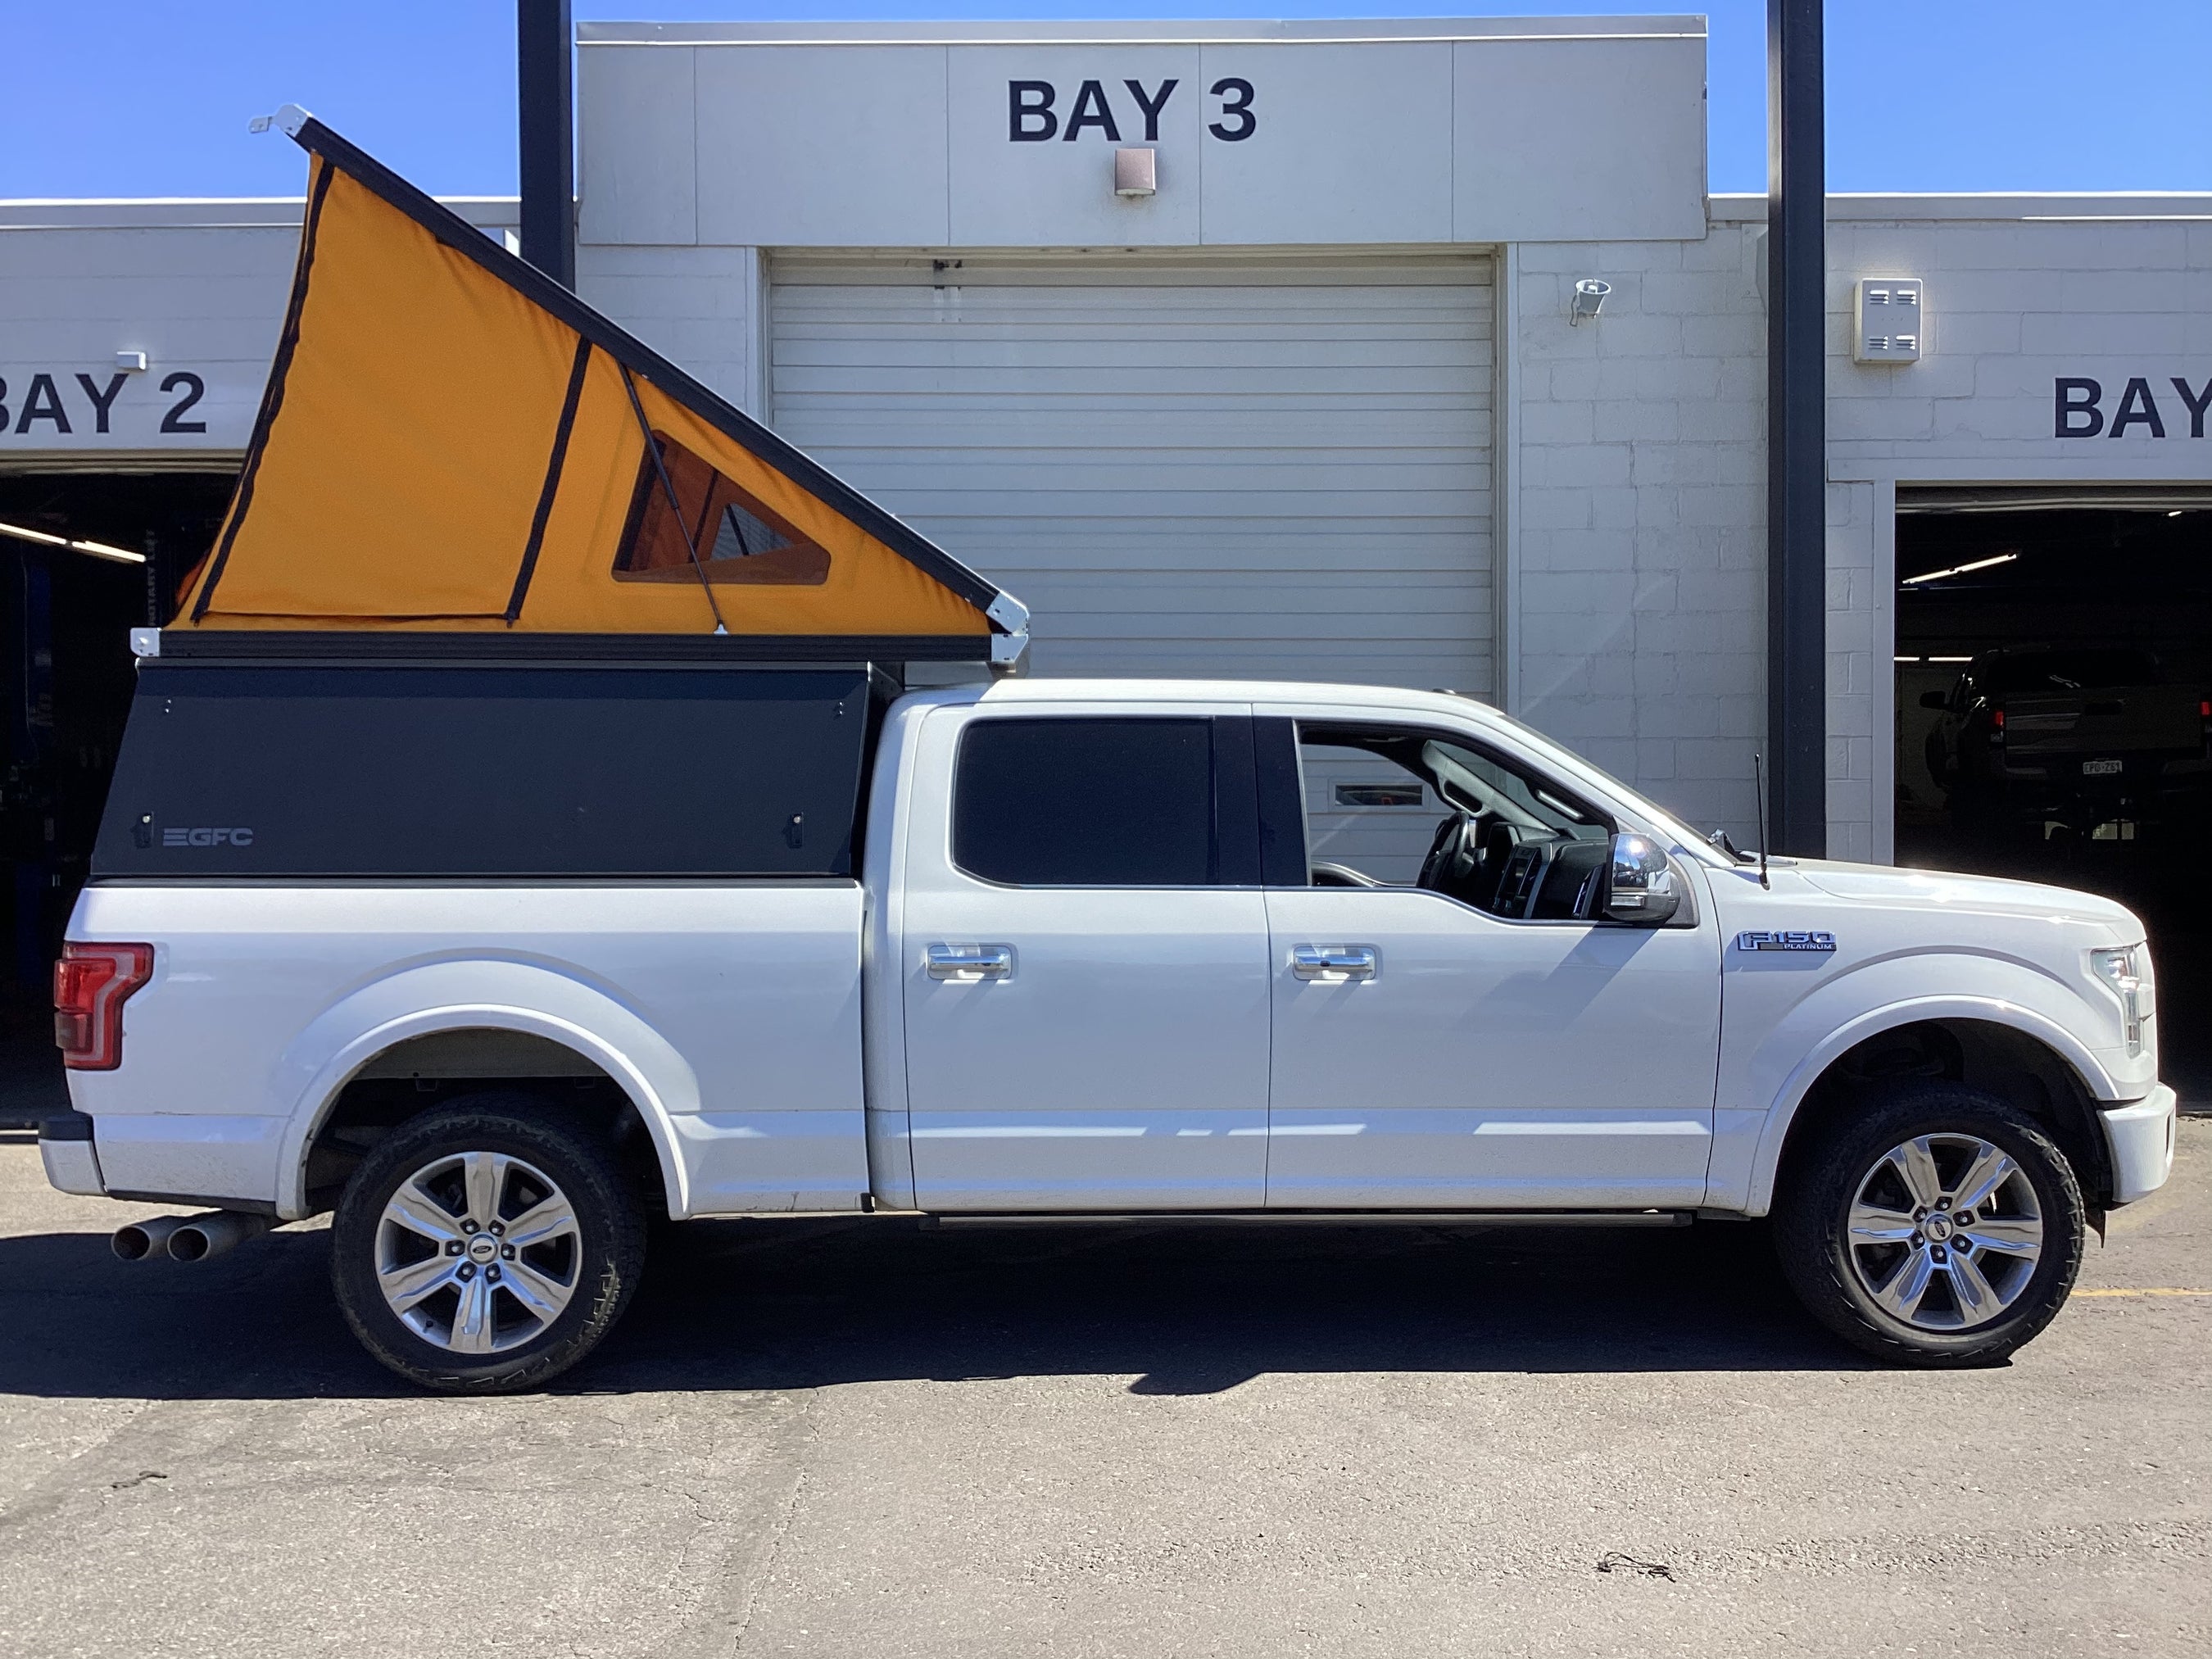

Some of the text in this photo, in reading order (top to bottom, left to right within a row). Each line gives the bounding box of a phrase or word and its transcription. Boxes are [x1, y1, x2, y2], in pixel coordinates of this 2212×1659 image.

[1009, 77, 1257, 142] BAY 3
[0, 371, 206, 434] AY 2
[2055, 377, 2212, 438] BAY
